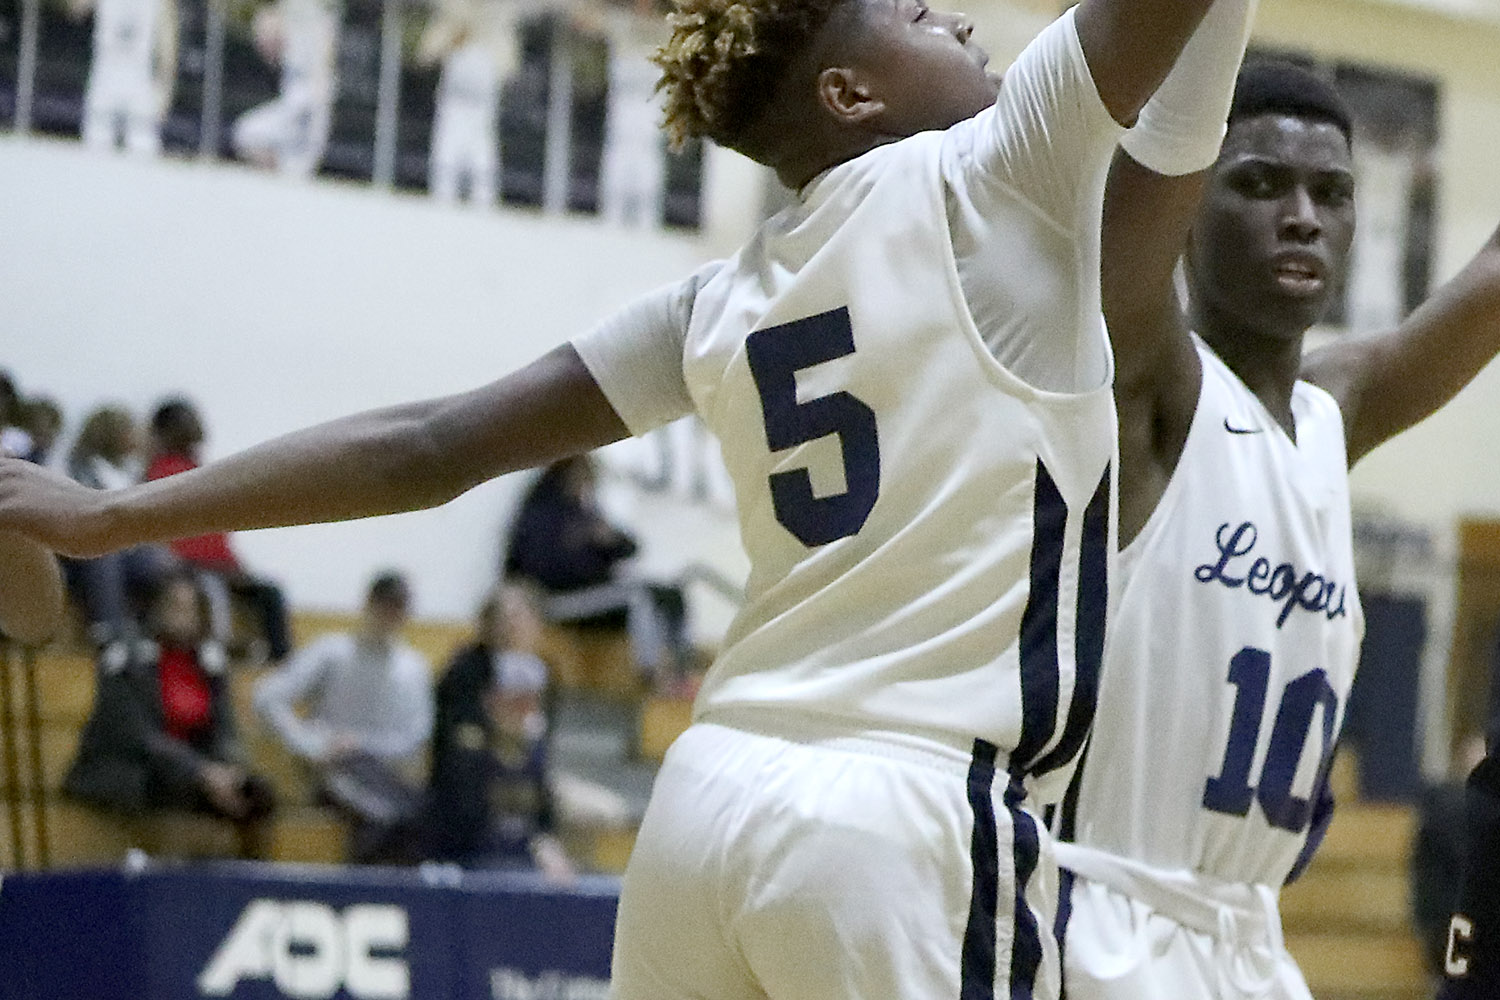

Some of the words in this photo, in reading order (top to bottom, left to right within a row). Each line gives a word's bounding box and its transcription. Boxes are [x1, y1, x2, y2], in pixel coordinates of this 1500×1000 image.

[745, 305, 880, 548] 5
[1202, 646, 1338, 835] 10
[1445, 915, 1471, 974] C
